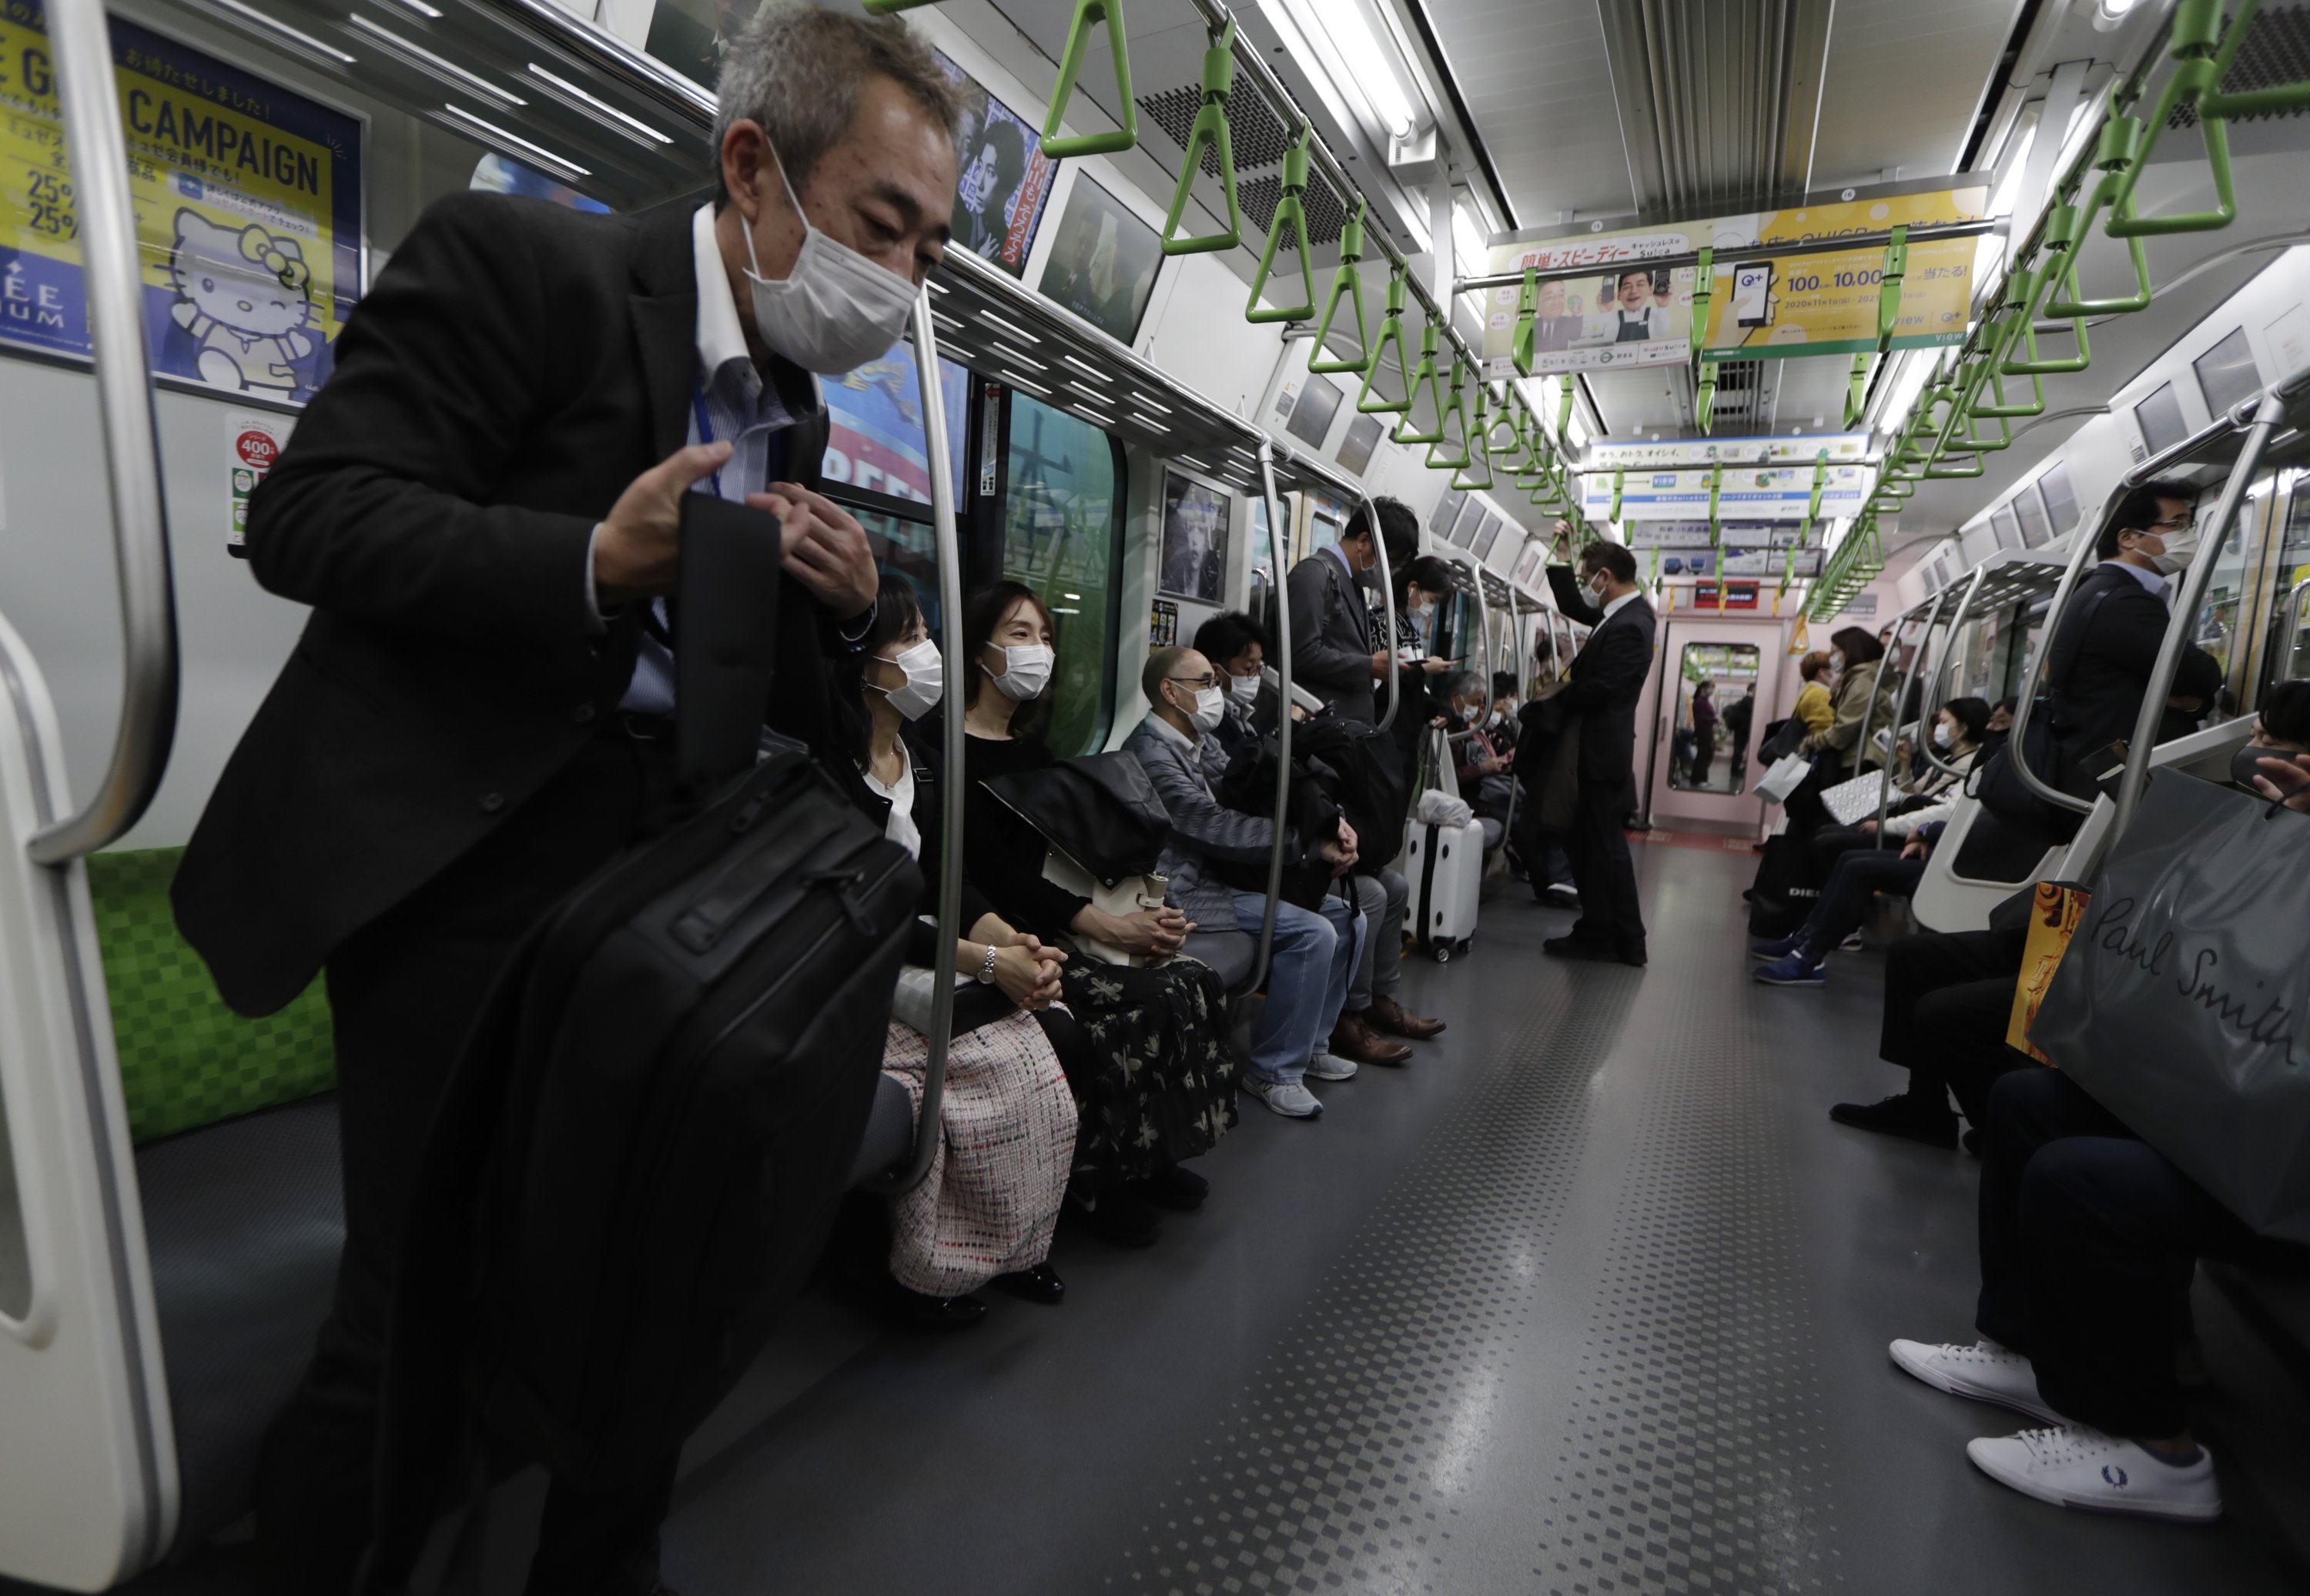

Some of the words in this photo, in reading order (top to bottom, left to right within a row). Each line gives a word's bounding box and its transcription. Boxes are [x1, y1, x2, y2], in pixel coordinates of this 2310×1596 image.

[128, 88, 319, 196] CAMPAIGN
[1520, 244, 1629, 269] 簡単・スピーディー
[1787, 275, 1820, 293] 100
[1833, 269, 1883, 288] 10,00
[1924, 265, 1968, 280] 当たる!
[241, 439, 270, 456] 400
[2089, 897, 2174, 976] Paul
[2177, 947, 2298, 1067] Smith
